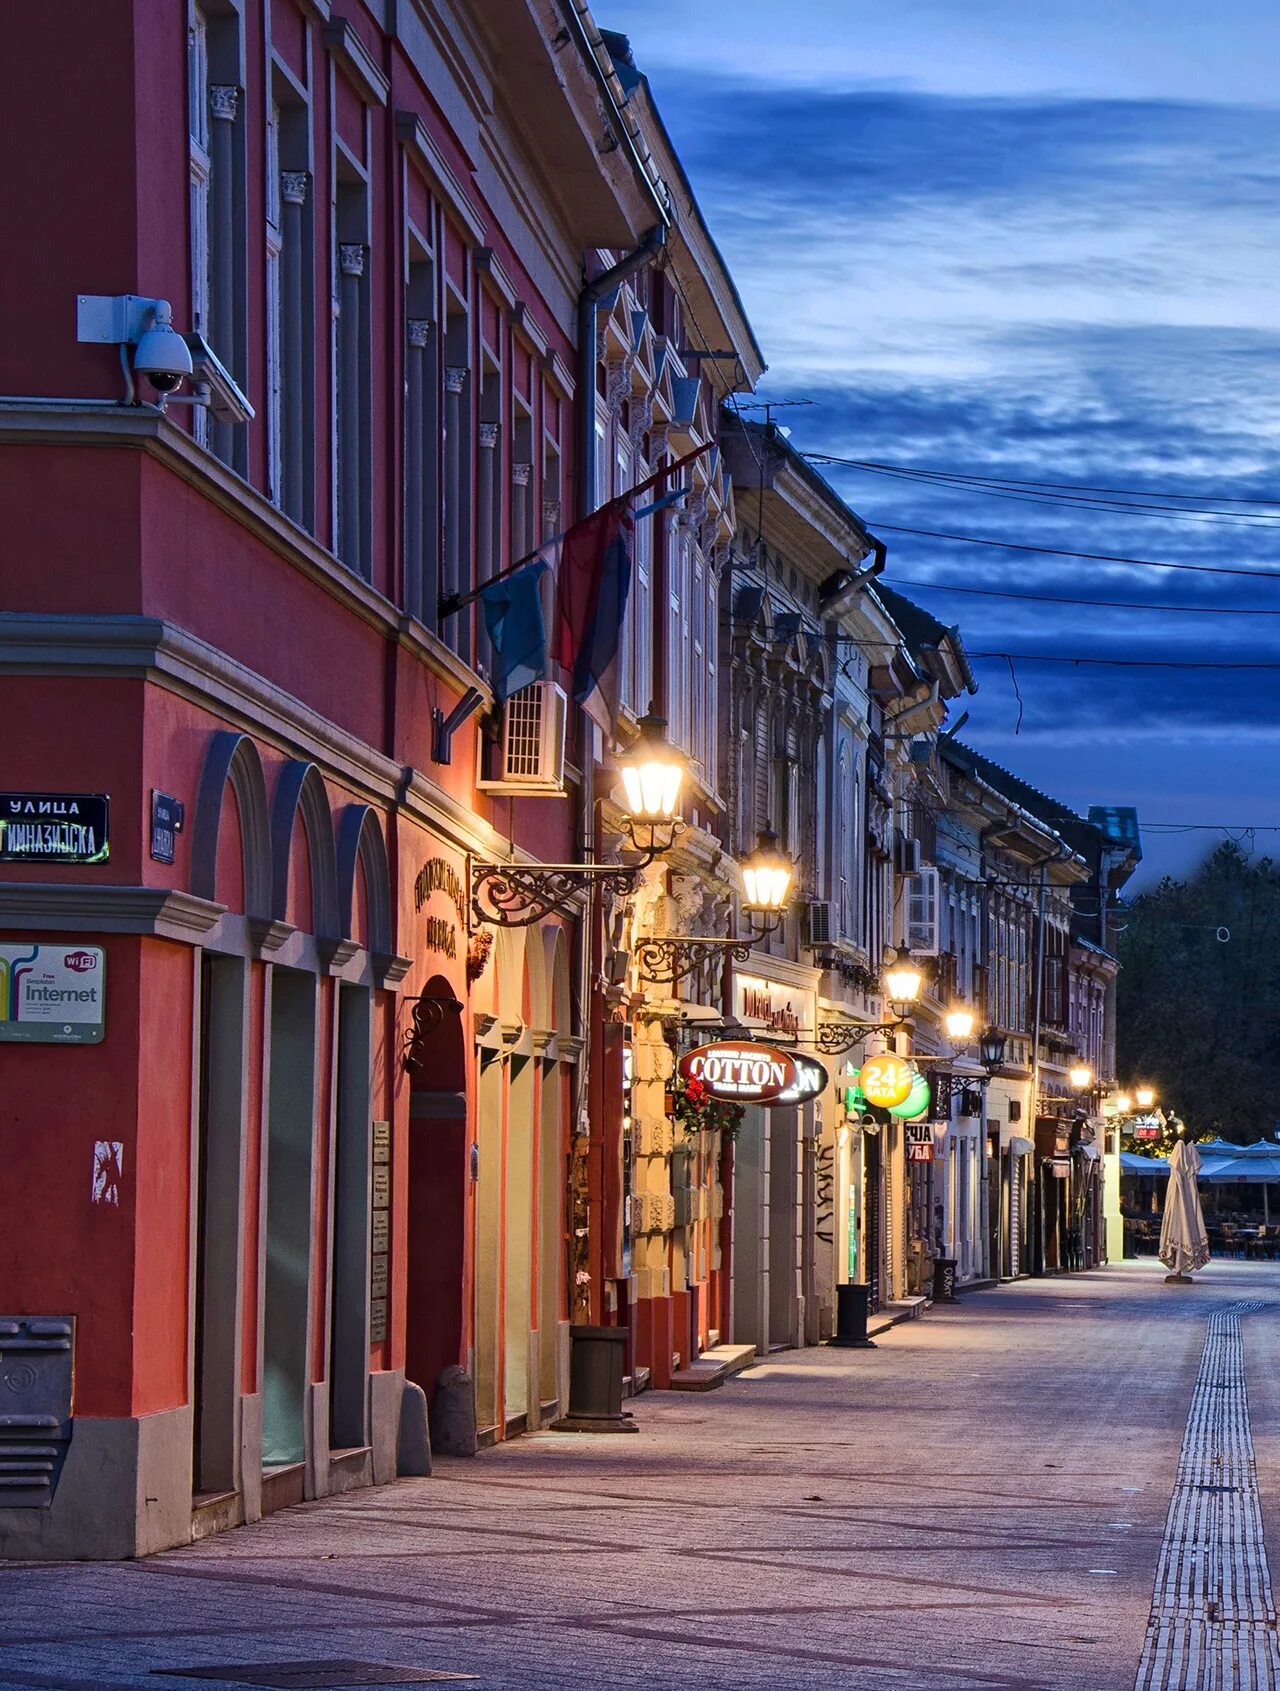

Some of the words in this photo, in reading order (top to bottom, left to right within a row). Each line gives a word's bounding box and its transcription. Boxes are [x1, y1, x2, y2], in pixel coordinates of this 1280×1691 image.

[10, 800, 80, 814] УЛИЦА
[25, 985, 98, 1002] Internet
[690, 1056, 787, 1087] COTTON
[866, 1063, 897, 1087] 24
[865, 1087, 896, 1097] SATA
